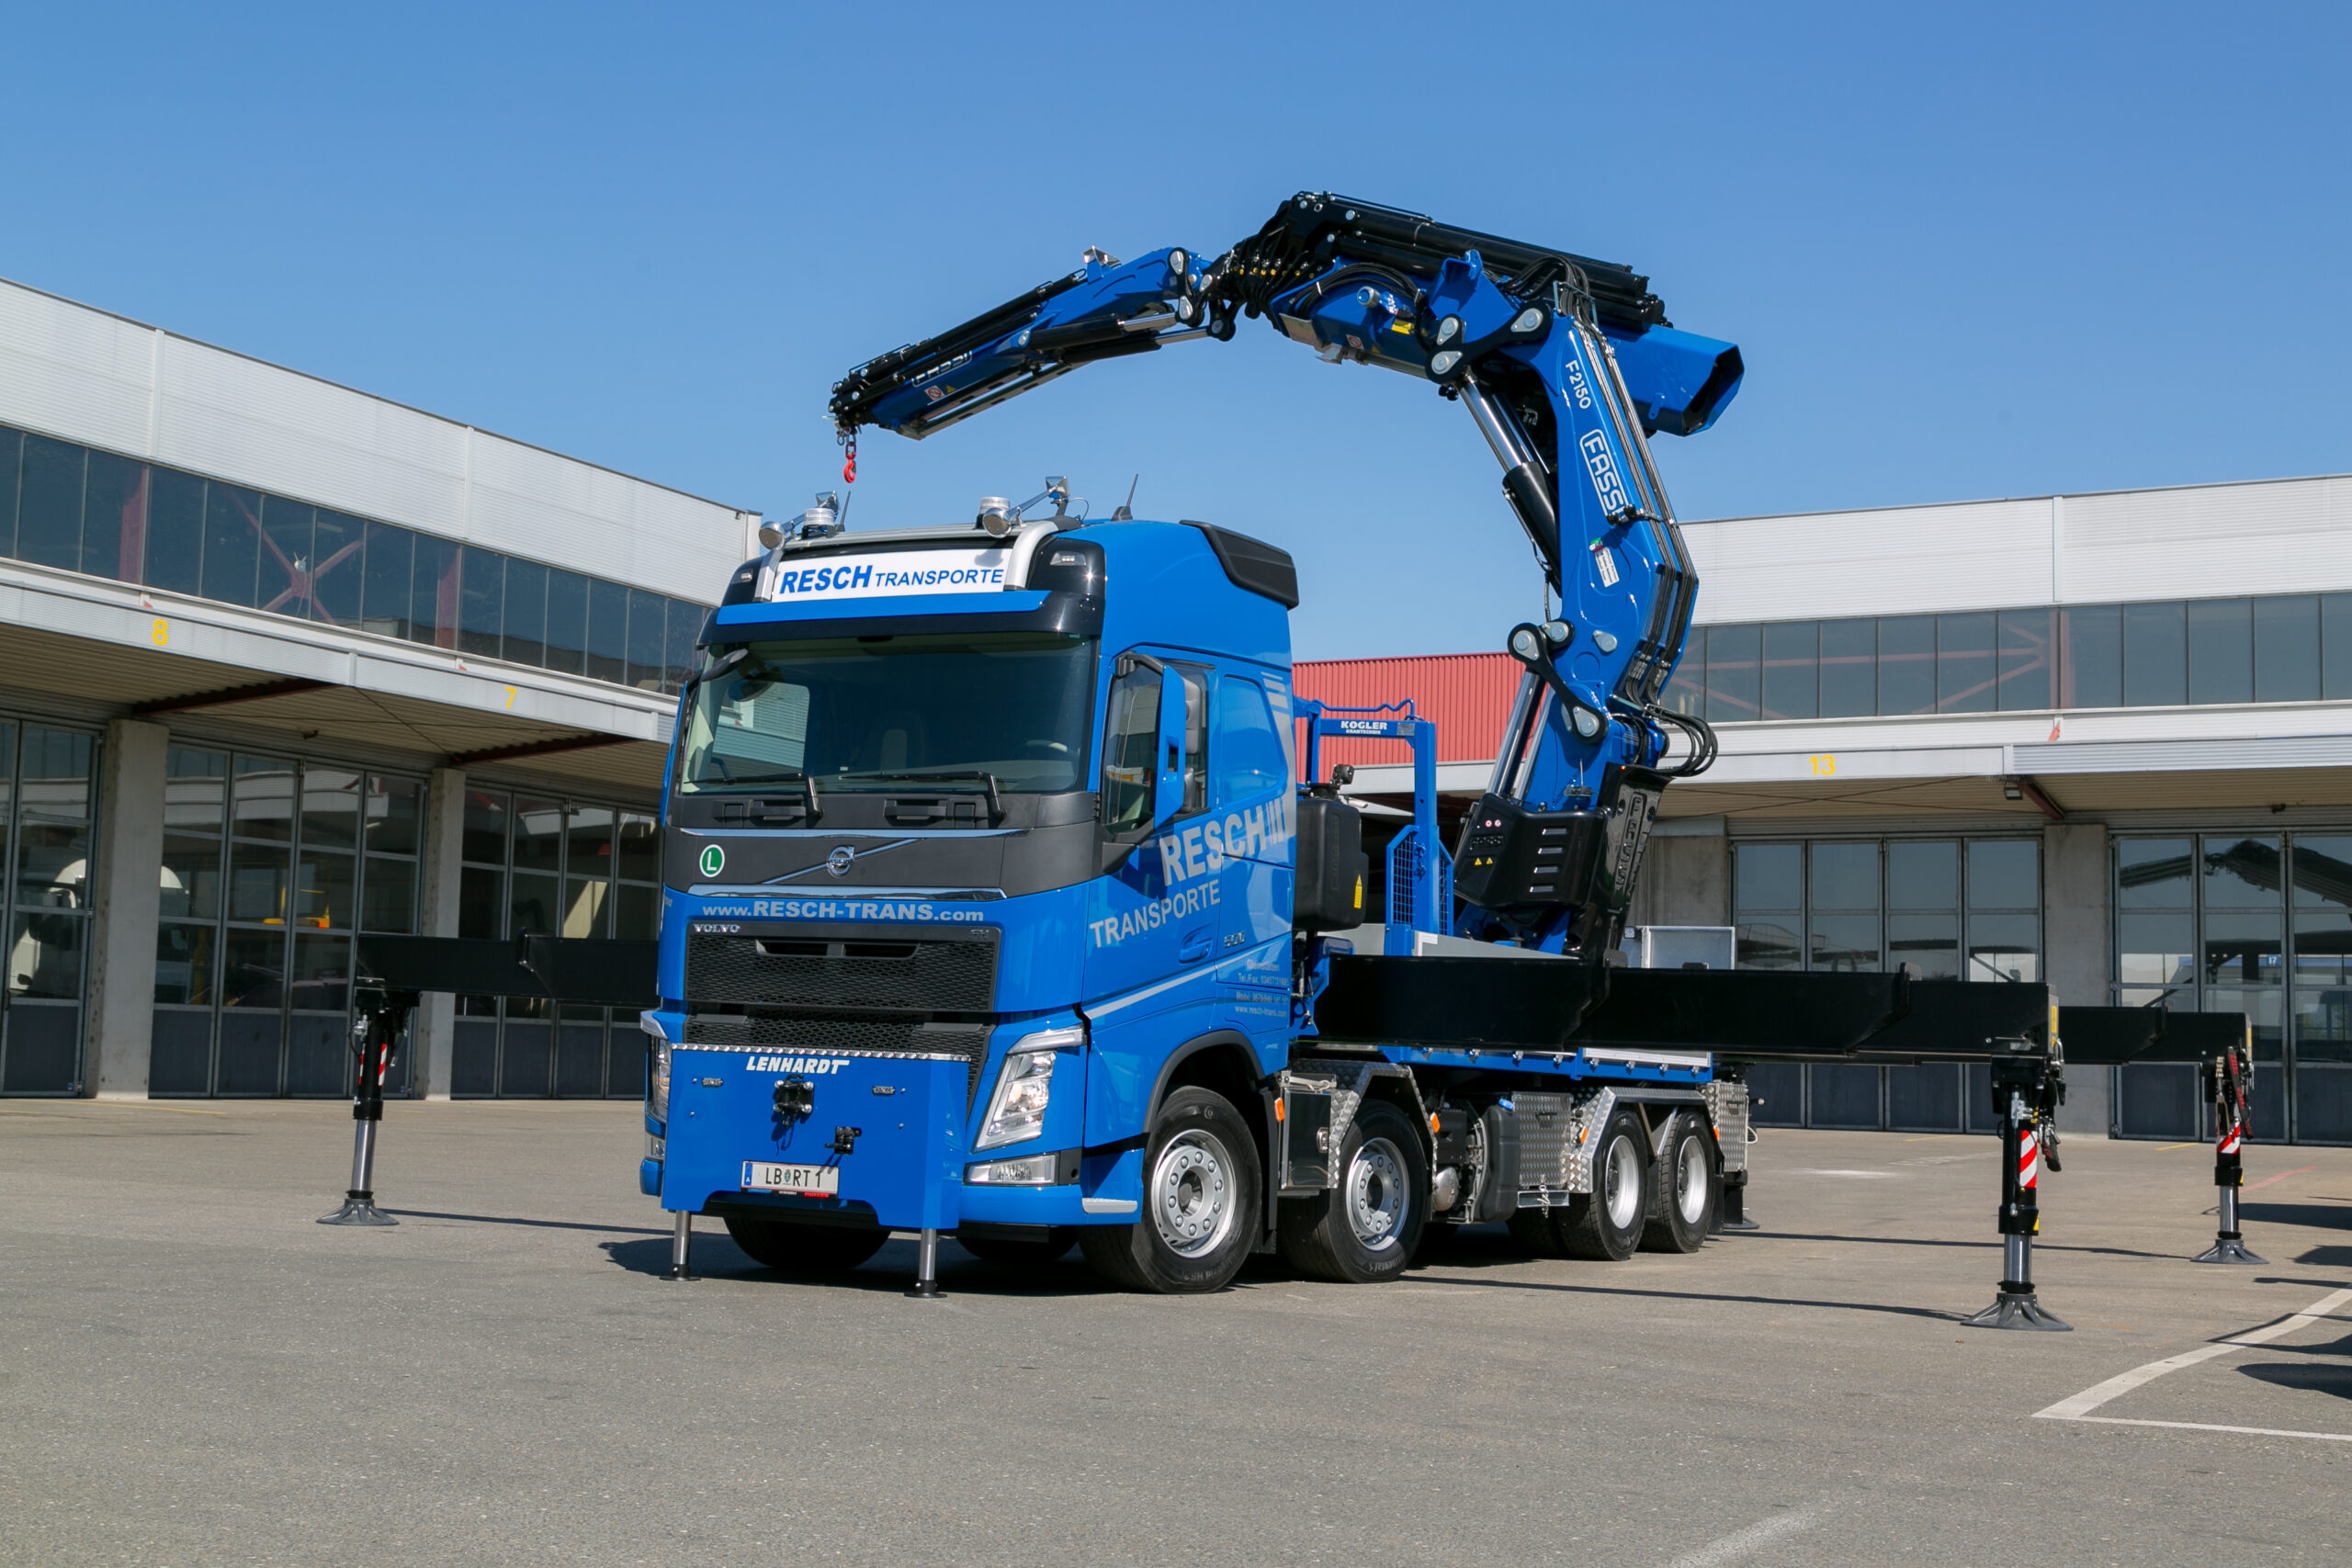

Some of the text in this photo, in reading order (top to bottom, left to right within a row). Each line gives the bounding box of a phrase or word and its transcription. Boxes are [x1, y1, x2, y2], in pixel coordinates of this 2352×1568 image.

[1566, 359, 1591, 410] F2150
[779, 565, 1004, 594] RESCH TRANSPORTE
[153, 618, 168, 646] 8
[504, 686, 517, 709] 7
[1340, 720, 1387, 730] KOGLER
[1808, 754, 1836, 776] 13
[1159, 805, 1269, 887] RESCH
[707, 851, 718, 872] L
[702, 901, 984, 921] www.RESCH-TRANS.com
[1090, 879, 1221, 949] TRANSPORTE
[693, 923, 741, 934] VOLVO
[1225, 931, 1246, 949] 500
[746, 1055, 850, 1075] LENHARDT
[765, 1168, 821, 1189] LB RT 1
